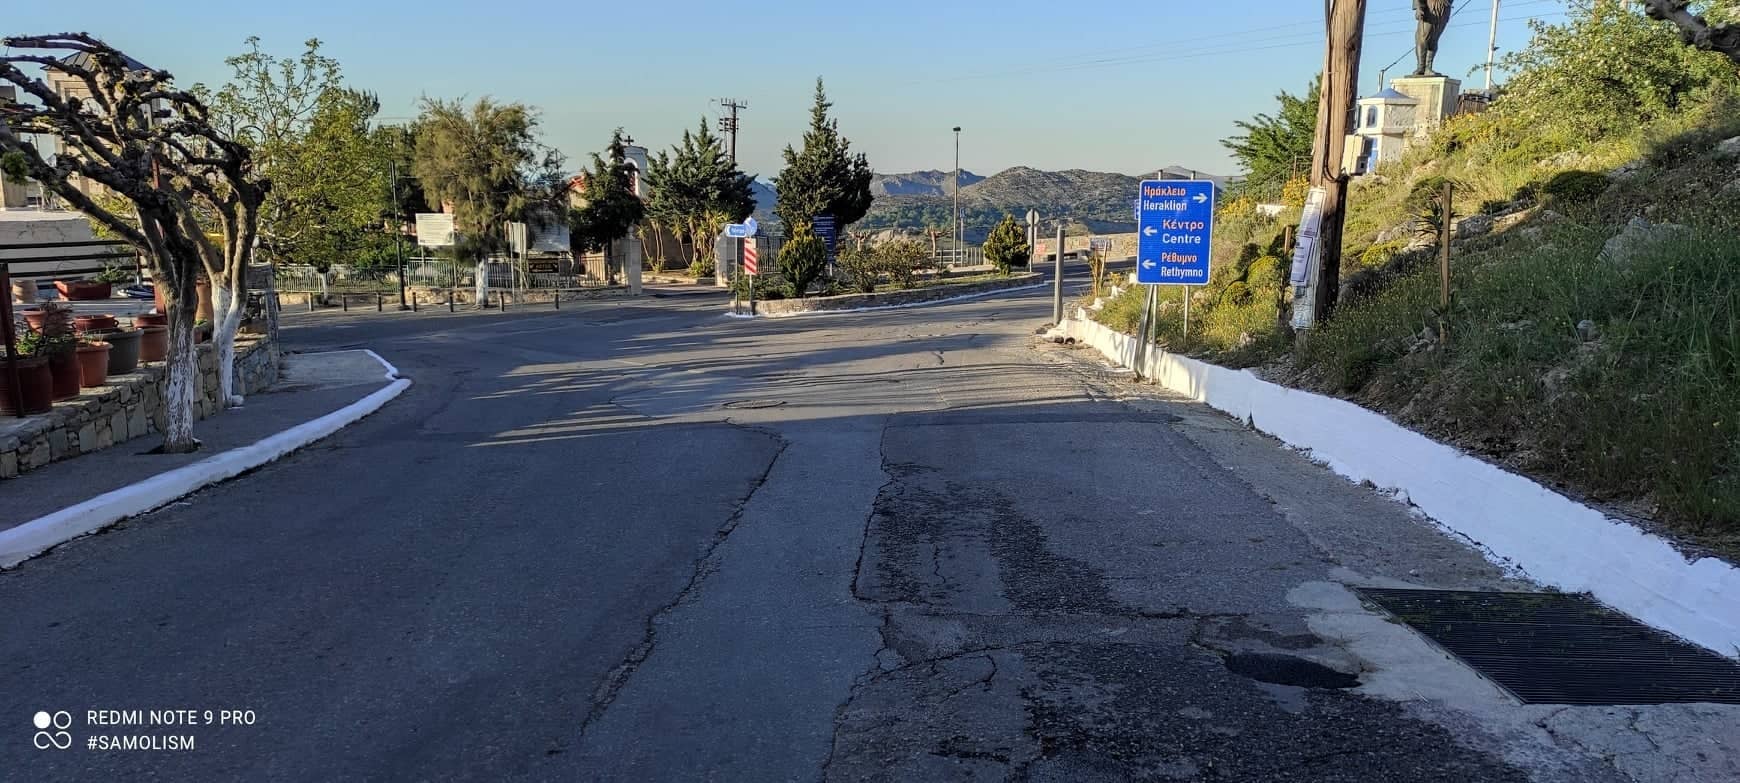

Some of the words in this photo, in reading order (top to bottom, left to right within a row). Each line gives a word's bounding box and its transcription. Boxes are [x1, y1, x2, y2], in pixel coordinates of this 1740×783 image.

[1144, 185, 1186, 198] Ηράκλειο
[1143, 201, 1187, 211] Heraklion
[1162, 219, 1204, 231] Κέντρο
[1162, 233, 1201, 244] Centre
[1161, 252, 1197, 265] Ρέθυμνο
[1161, 267, 1203, 279] Rethymno
